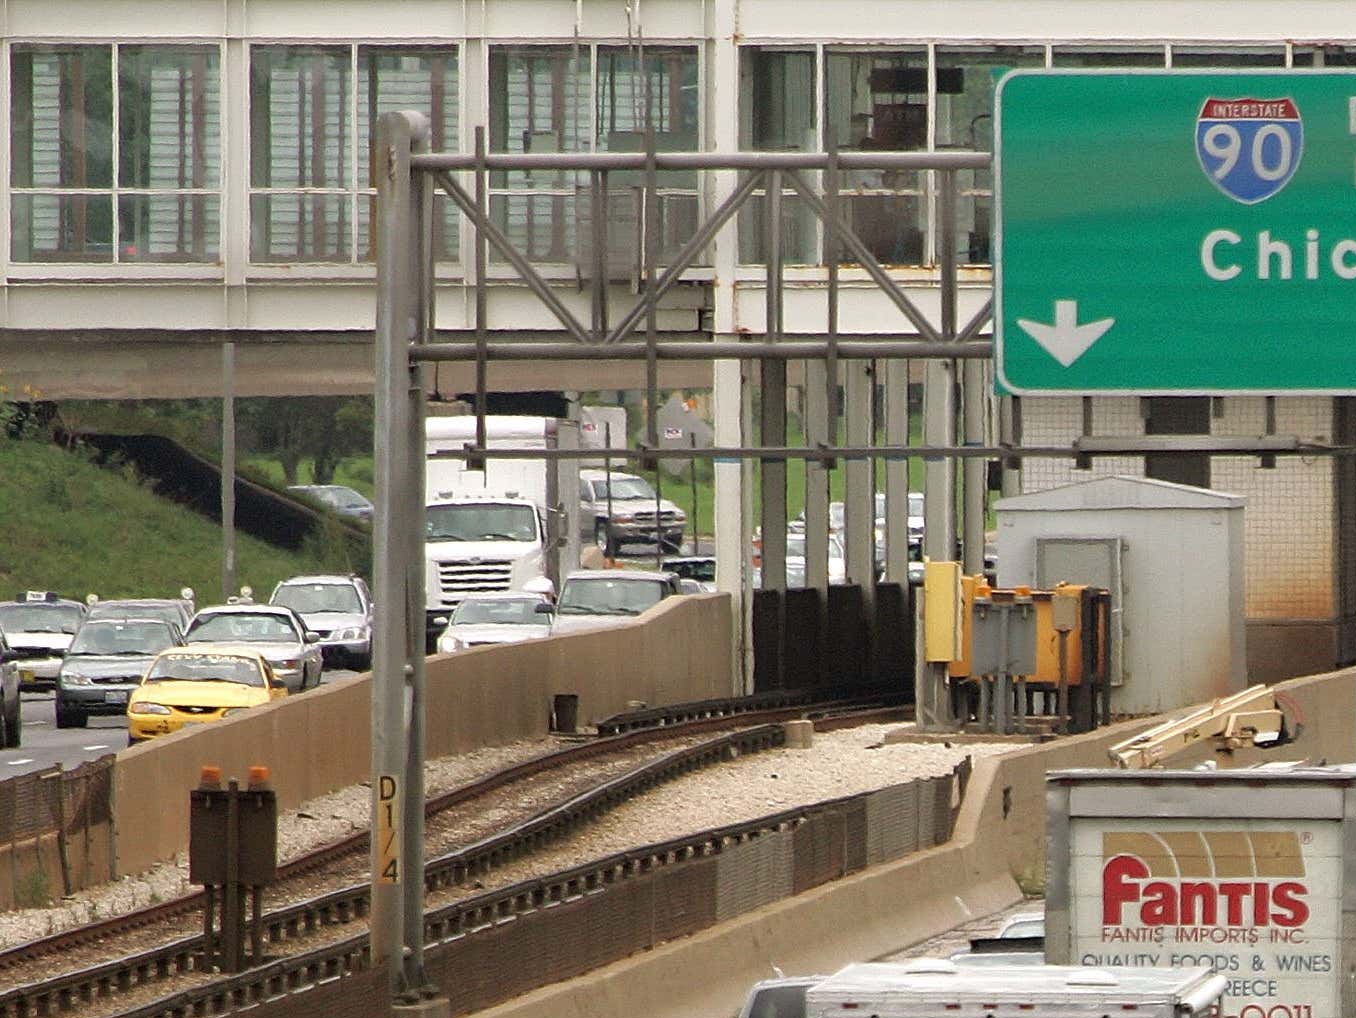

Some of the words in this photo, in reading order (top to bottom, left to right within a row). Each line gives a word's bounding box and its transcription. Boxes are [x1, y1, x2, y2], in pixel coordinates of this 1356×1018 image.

[1213, 104, 1286, 117] INTERSTATE
[1203, 124, 1292, 180] 90
[1102, 927, 1164, 944] FANTIS
[1175, 927, 1259, 944] IMPORTS
[1270, 927, 1309, 944] INC.
[1252, 954, 1265, 972] &
[1277, 954, 1332, 972] WINES
[1223, 980, 1277, 997] REECE
